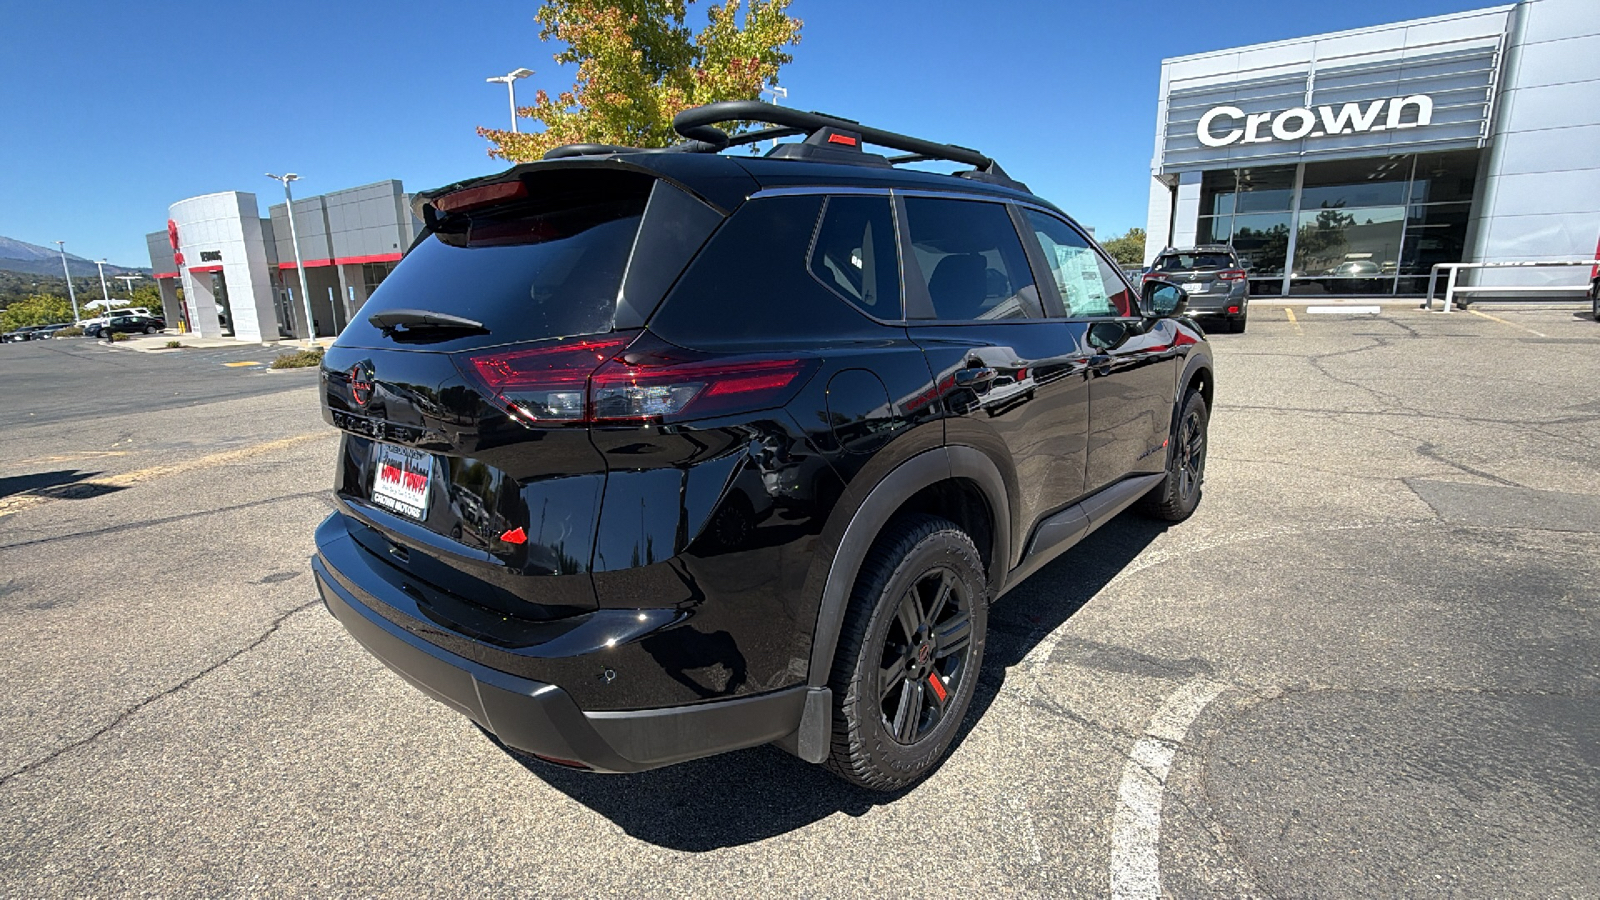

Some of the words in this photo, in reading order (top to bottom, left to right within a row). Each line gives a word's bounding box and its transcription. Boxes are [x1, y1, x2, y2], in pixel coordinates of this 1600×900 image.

[1197, 94, 1434, 147] Crown
[374, 492, 396, 508] CROWN
[394, 500, 421, 518] MOTORS
